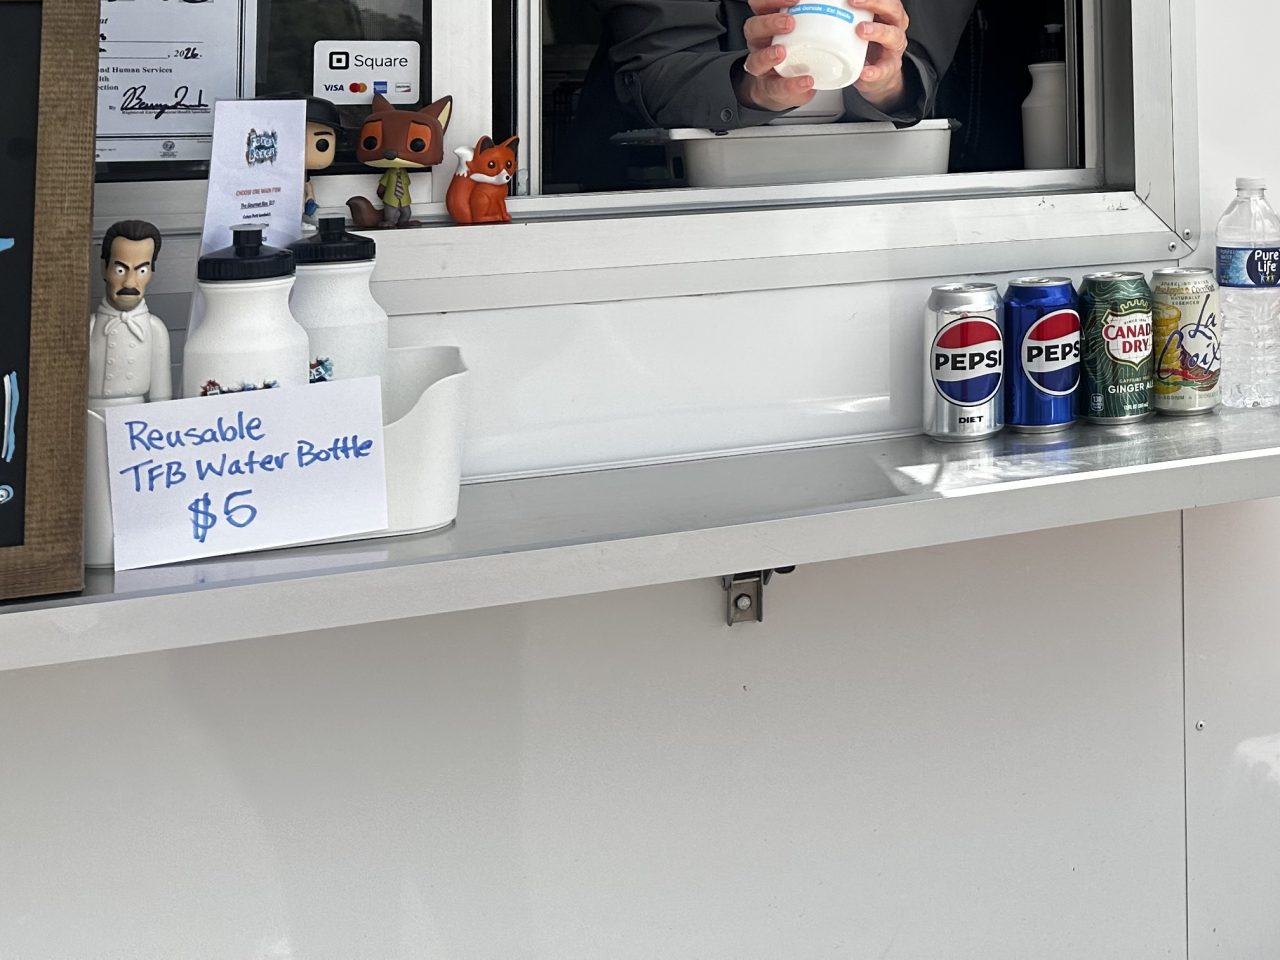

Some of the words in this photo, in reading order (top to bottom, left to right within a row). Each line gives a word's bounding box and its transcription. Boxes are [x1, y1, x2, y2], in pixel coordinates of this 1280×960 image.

[354, 54, 408, 70] Square
[324, 84, 345, 92] VISA
[1254, 250, 1279, 261] Pure
[1257, 260, 1278, 275] Life
[1188, 294, 1217, 339] La
[1103, 323, 1151, 341] CANAD
[1027, 340, 1080, 363] PEPS
[1122, 339, 1149, 354] DRY
[1108, 383, 1144, 394] GINGER
[959, 416, 984, 424] DIET
[125, 411, 265, 451] Reusable
[119, 460, 187, 492] TFB
[196, 450, 290, 481] Water
[296, 435, 373, 468] Bottle
[188, 489, 257, 543] $5
